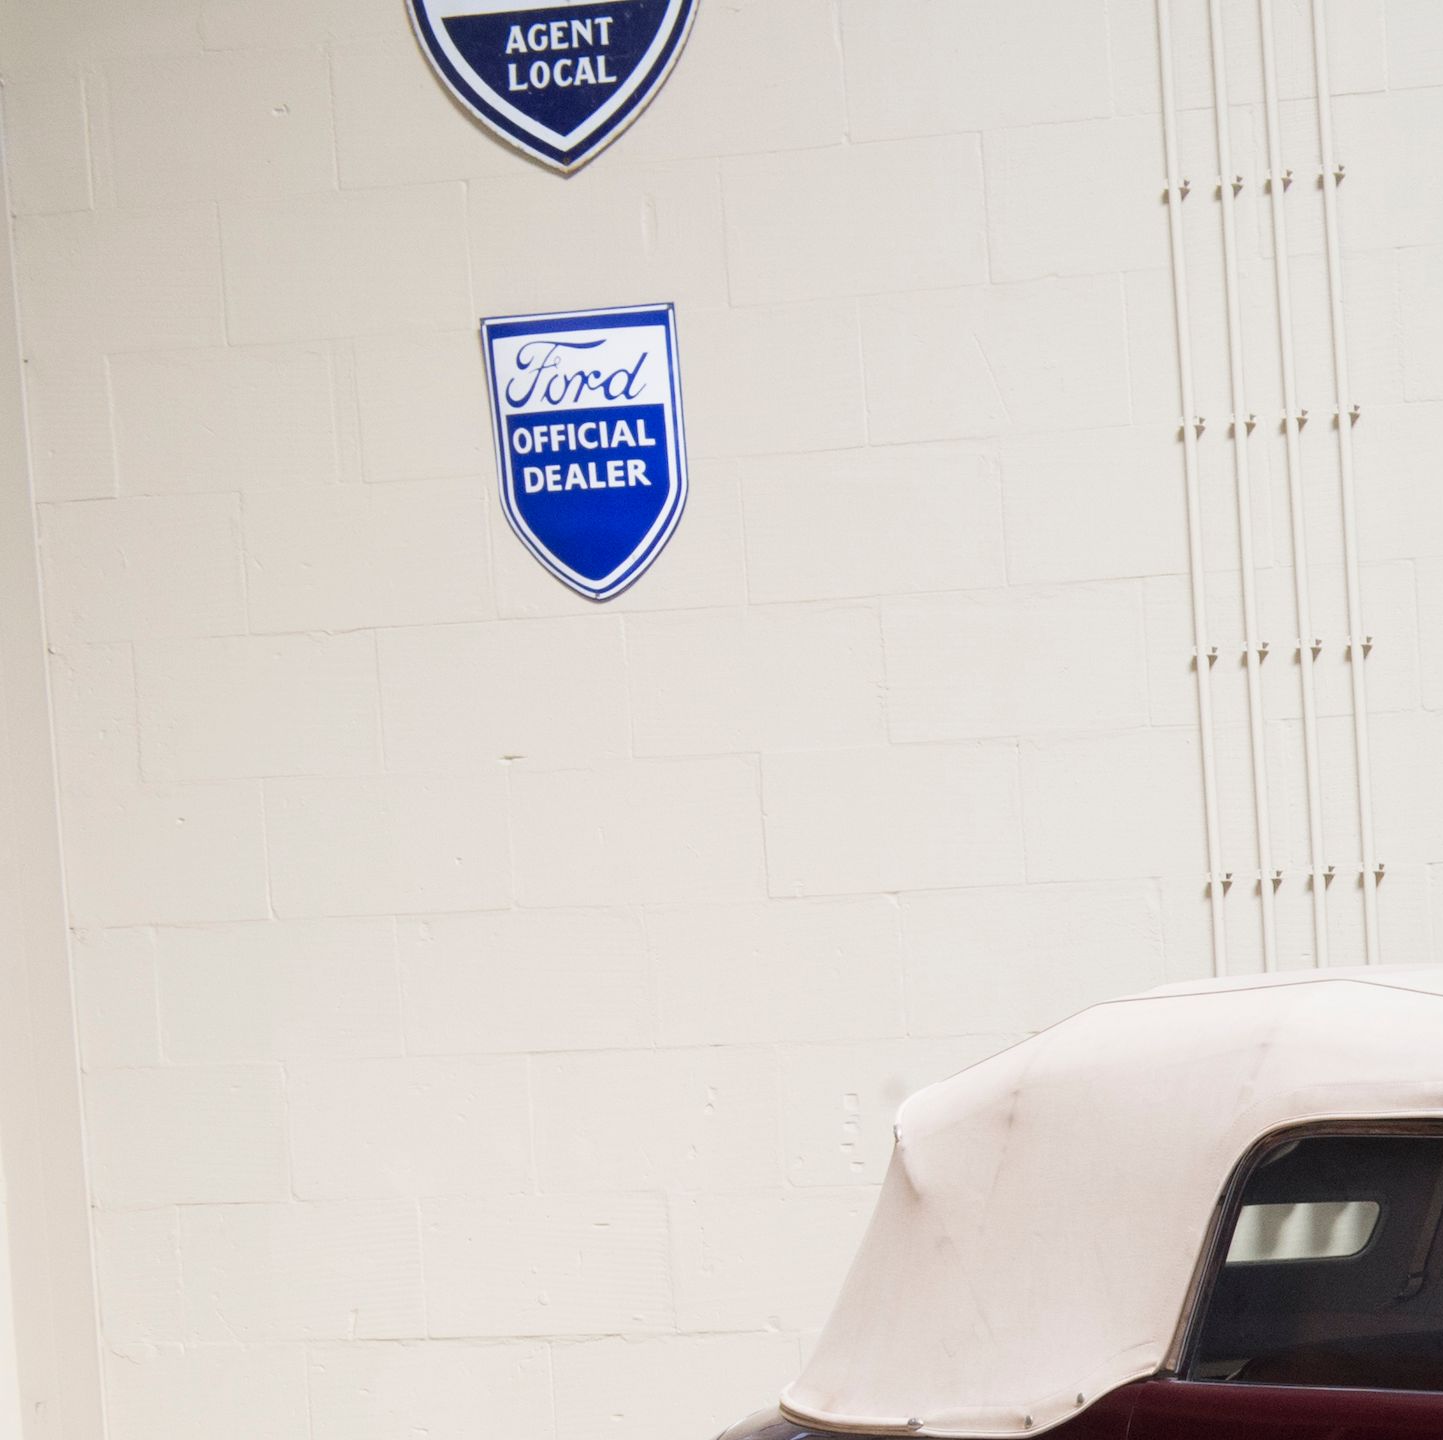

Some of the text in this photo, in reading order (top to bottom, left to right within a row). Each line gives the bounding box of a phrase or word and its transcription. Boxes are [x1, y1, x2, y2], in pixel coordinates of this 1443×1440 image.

[505, 17, 613, 54] AGENT
[508, 55, 617, 91] LOCAL
[505, 339, 650, 406] Ford
[513, 417, 656, 454] OFFICIAL
[523, 459, 651, 493] DEALER
